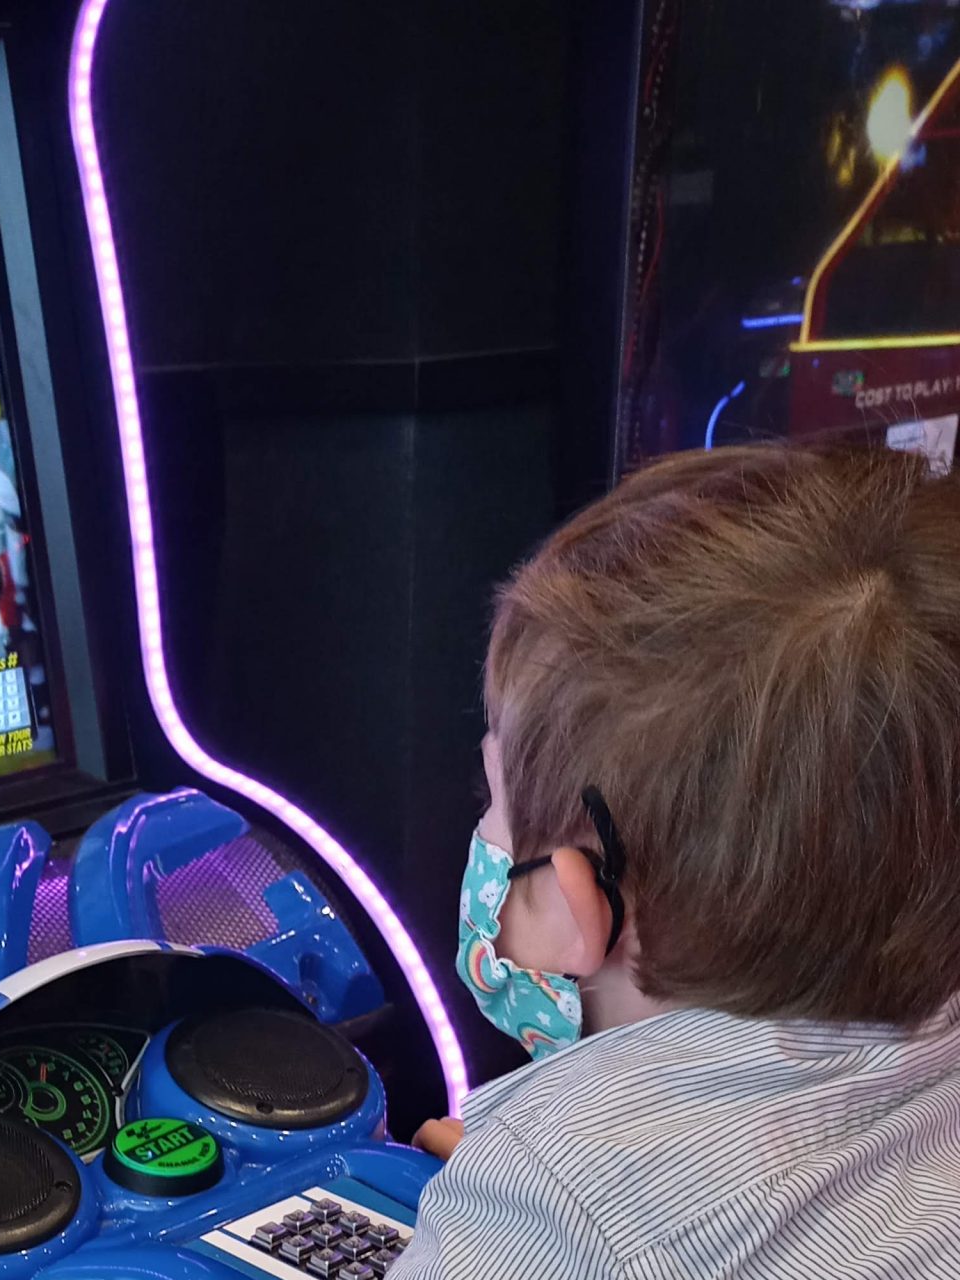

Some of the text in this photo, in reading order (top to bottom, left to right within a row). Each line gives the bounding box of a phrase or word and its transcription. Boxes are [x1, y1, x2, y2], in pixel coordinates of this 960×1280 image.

[855, 387, 892, 408] COST
[895, 383, 913, 401] TO
[7, 738, 33, 756] STATS
[135, 1127, 194, 1161] START
